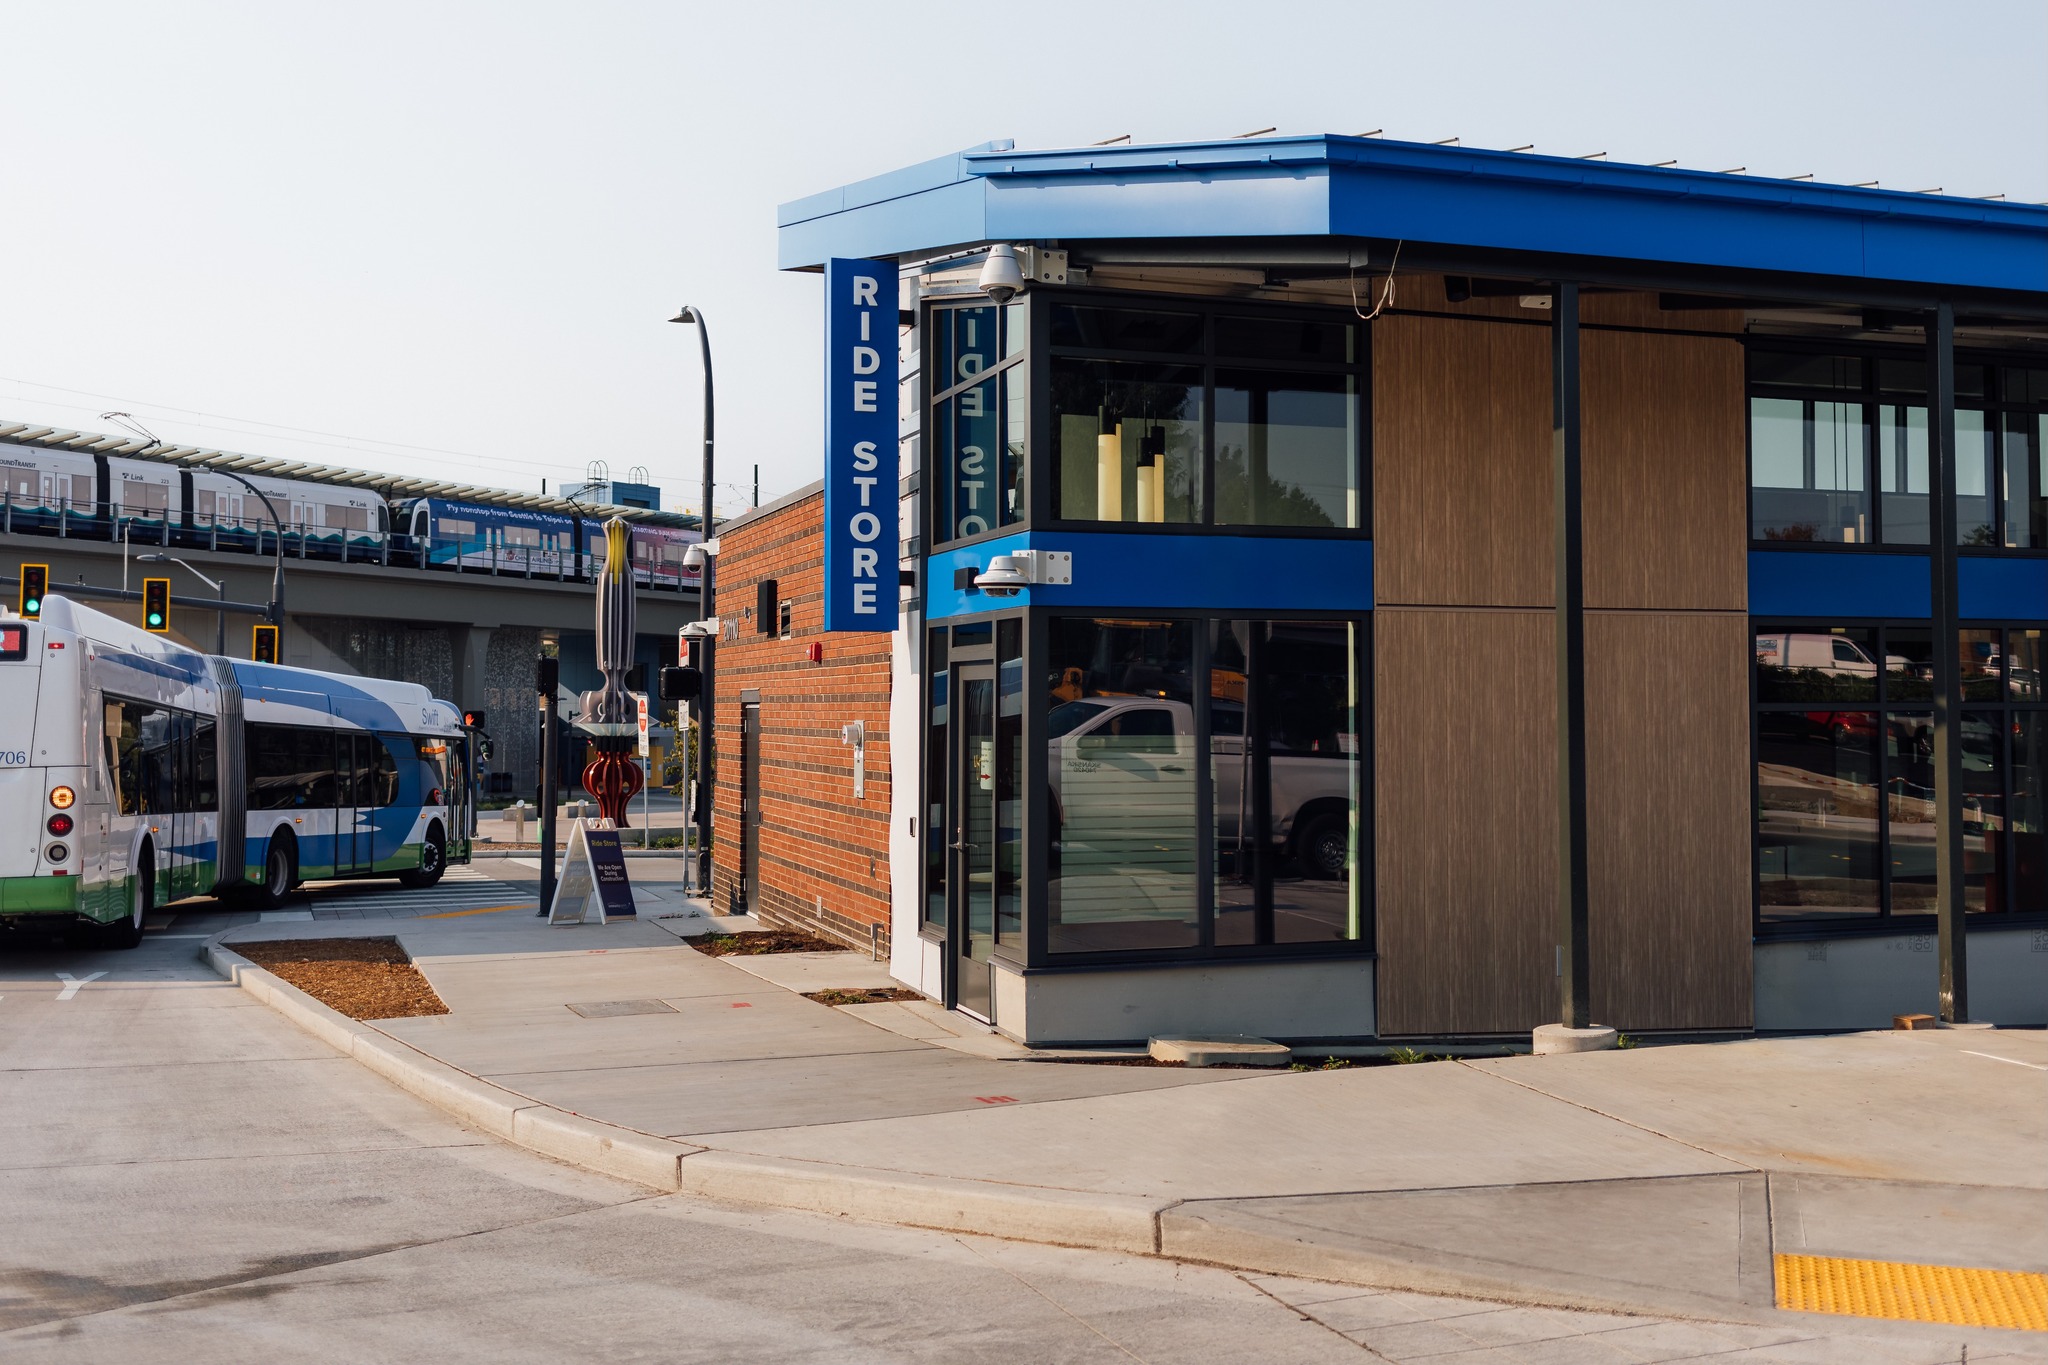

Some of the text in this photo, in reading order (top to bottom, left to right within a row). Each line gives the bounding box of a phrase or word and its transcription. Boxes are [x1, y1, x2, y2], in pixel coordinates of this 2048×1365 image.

[850, 275, 881, 614] RIDE STORE
[0, 459, 36, 469] OUNDTRANSIT
[130, 473, 144, 481] Link
[446, 504, 459, 514] Fly
[460, 507, 490, 517] nonstop
[490, 509, 508, 518] from
[508, 510, 534, 520] Seattle
[542, 515, 564, 524] Taipei
[581, 519, 601, 528] China
[422, 707, 439, 726] Swift
[604, 870, 618, 878] During
